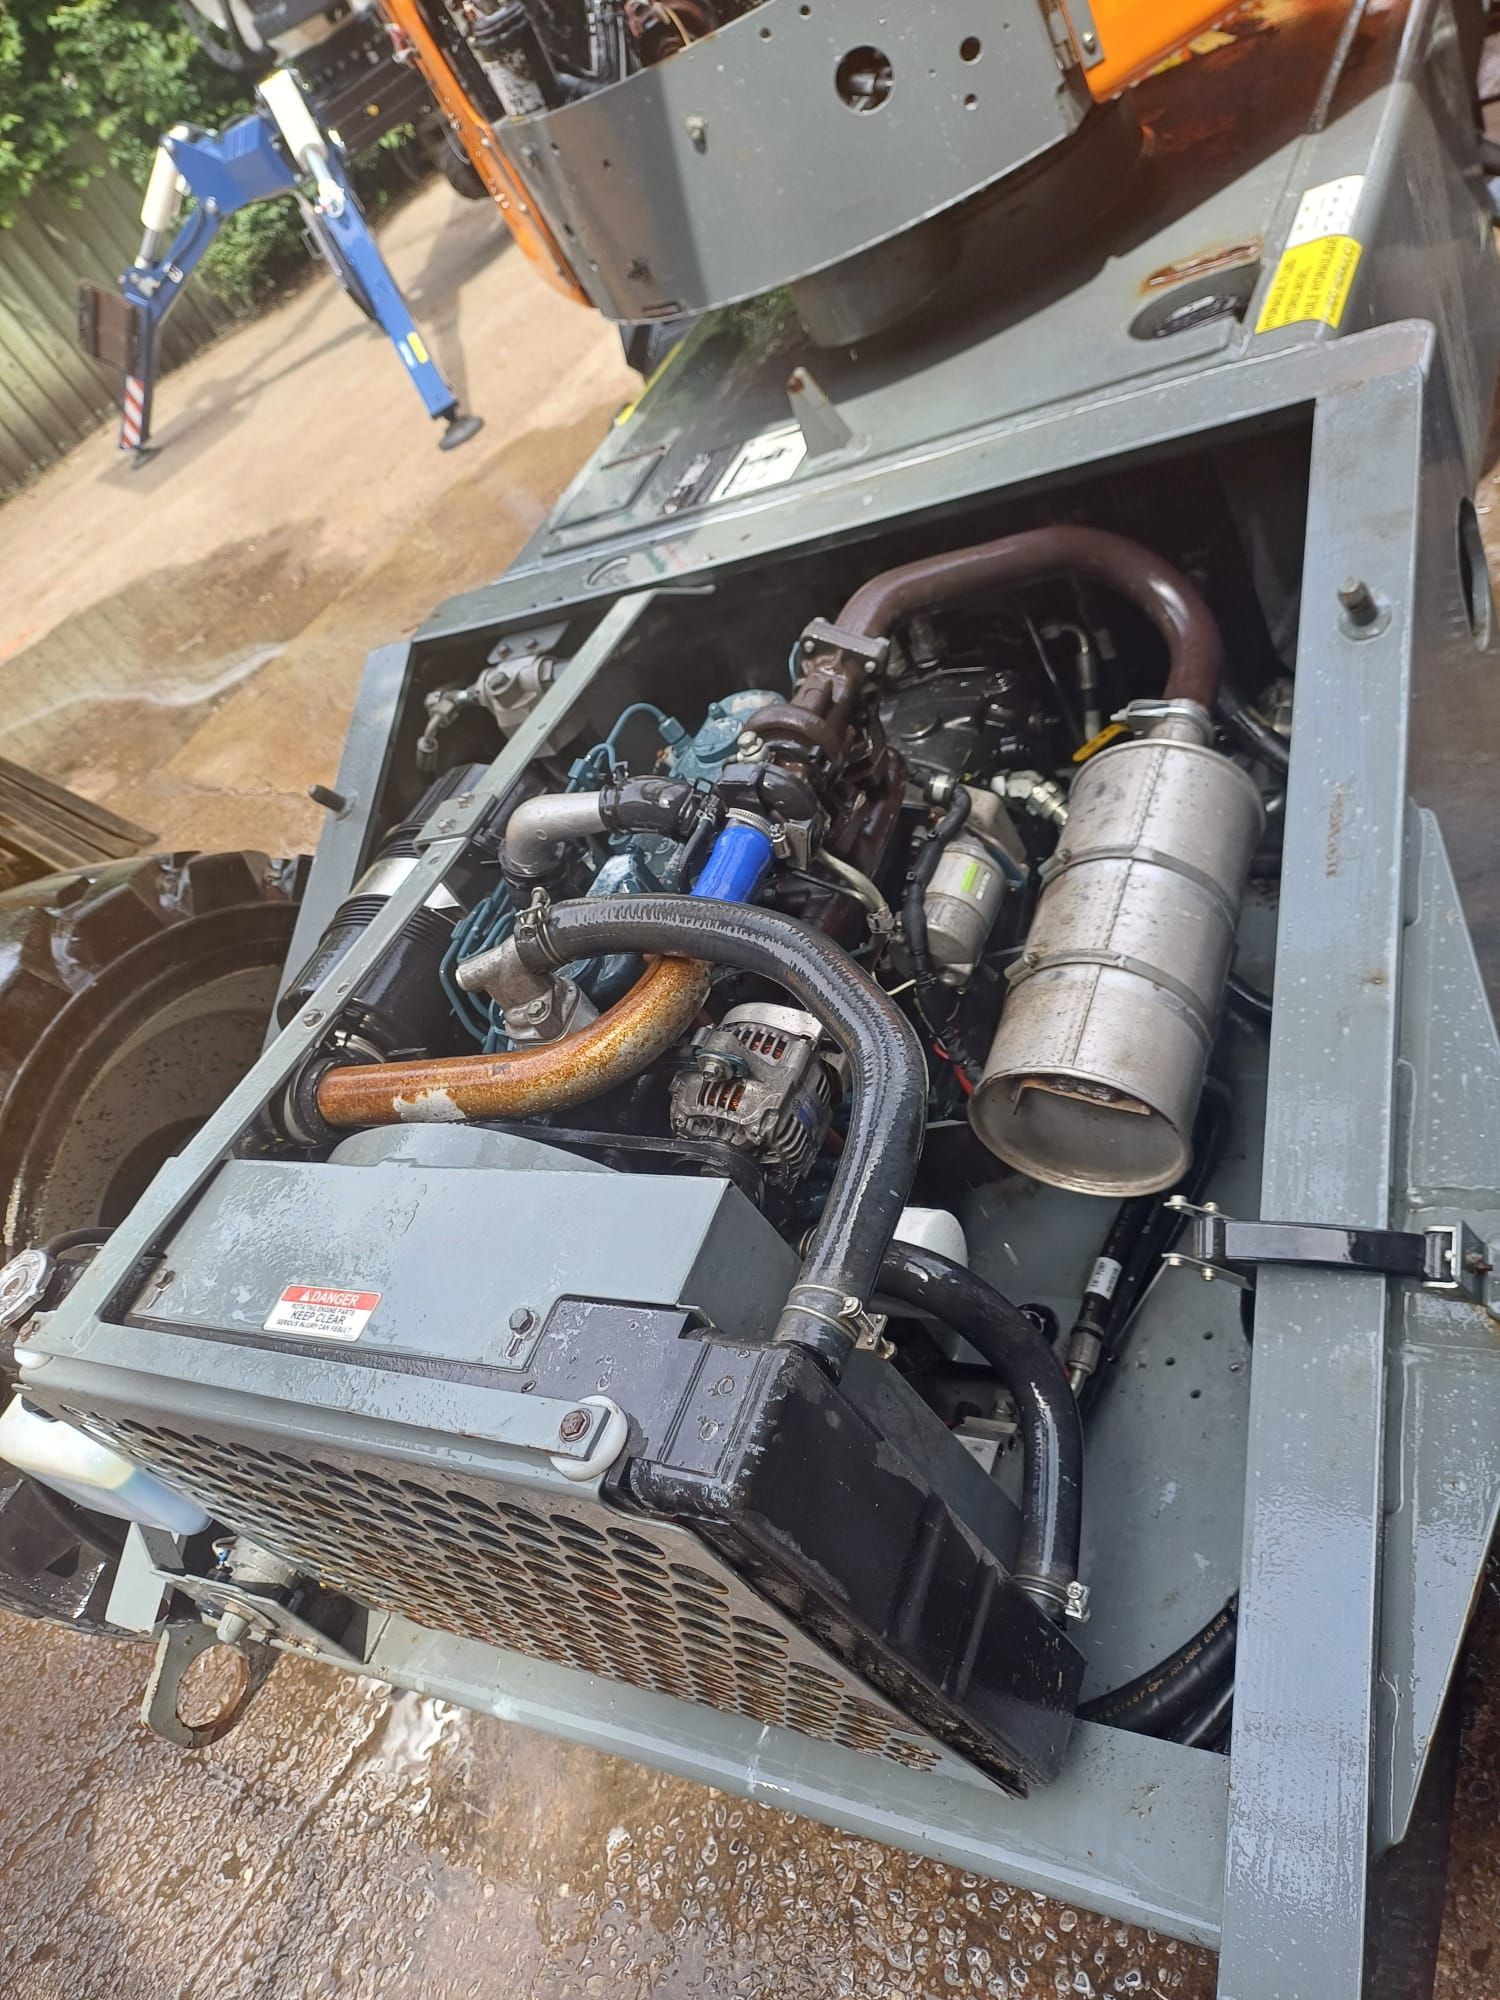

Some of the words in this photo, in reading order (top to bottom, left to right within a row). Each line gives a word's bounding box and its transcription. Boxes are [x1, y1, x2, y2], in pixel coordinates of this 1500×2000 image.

[311, 1290, 360, 1306] DANGER
[291, 1303, 317, 1311] ROTATING
[317, 1305, 337, 1313] ENGINE
[337, 1308, 356, 1316] PARTS
[290, 1310, 315, 1320] KEEP
[315, 1312, 346, 1325] CLEAR
[276, 1319, 298, 1327] SERIOUS
[298, 1321, 318, 1329] INJURY
[330, 1325, 352, 1333] RESULT
